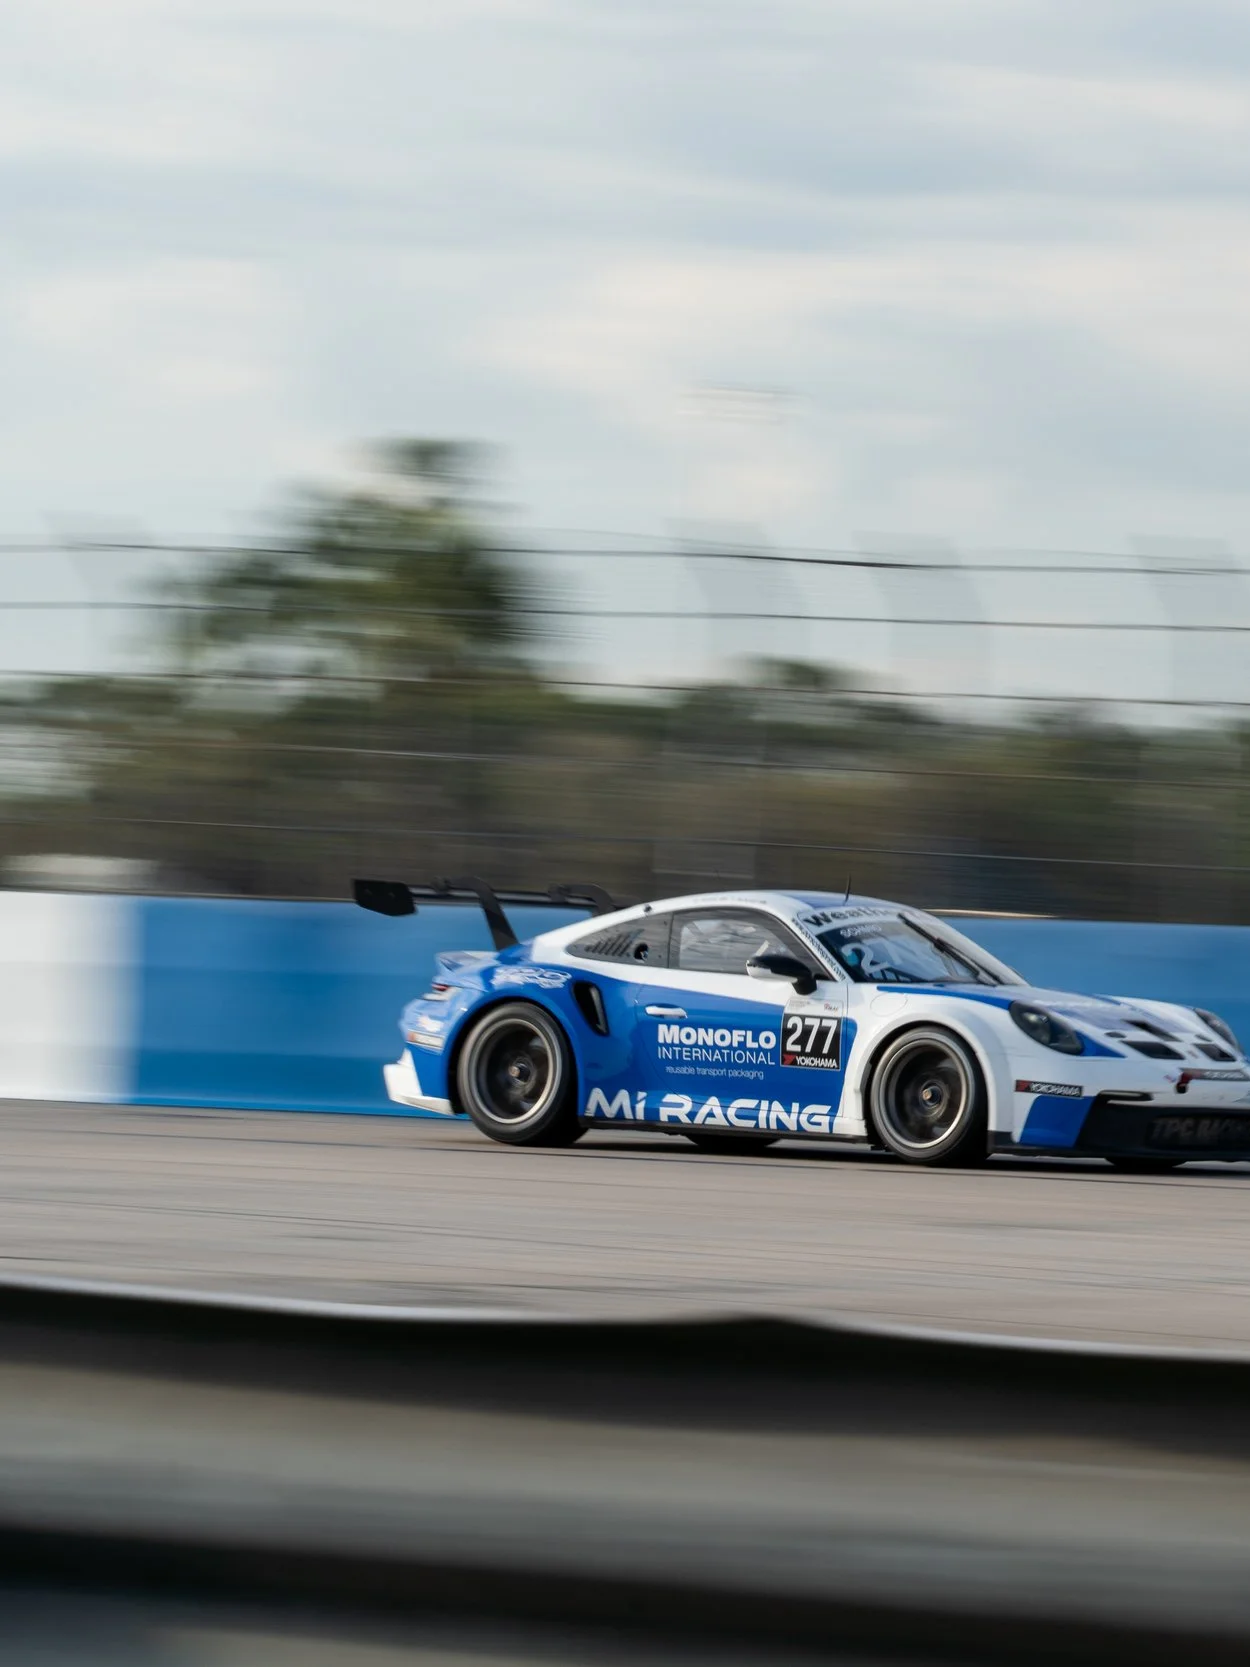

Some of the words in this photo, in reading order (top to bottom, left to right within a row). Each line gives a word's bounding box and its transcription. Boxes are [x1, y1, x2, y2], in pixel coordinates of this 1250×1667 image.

[657, 1024, 777, 1050] MONOFLO
[786, 1016, 838, 1054] 277
[657, 1046, 776, 1066] INTERNATIONAL
[796, 1056, 838, 1068] YOKOHAMA
[665, 1066, 696, 1075] reusable
[696, 1067, 727, 1077] transport
[728, 1069, 765, 1080] packaging
[659, 1093, 832, 1133] RACING
